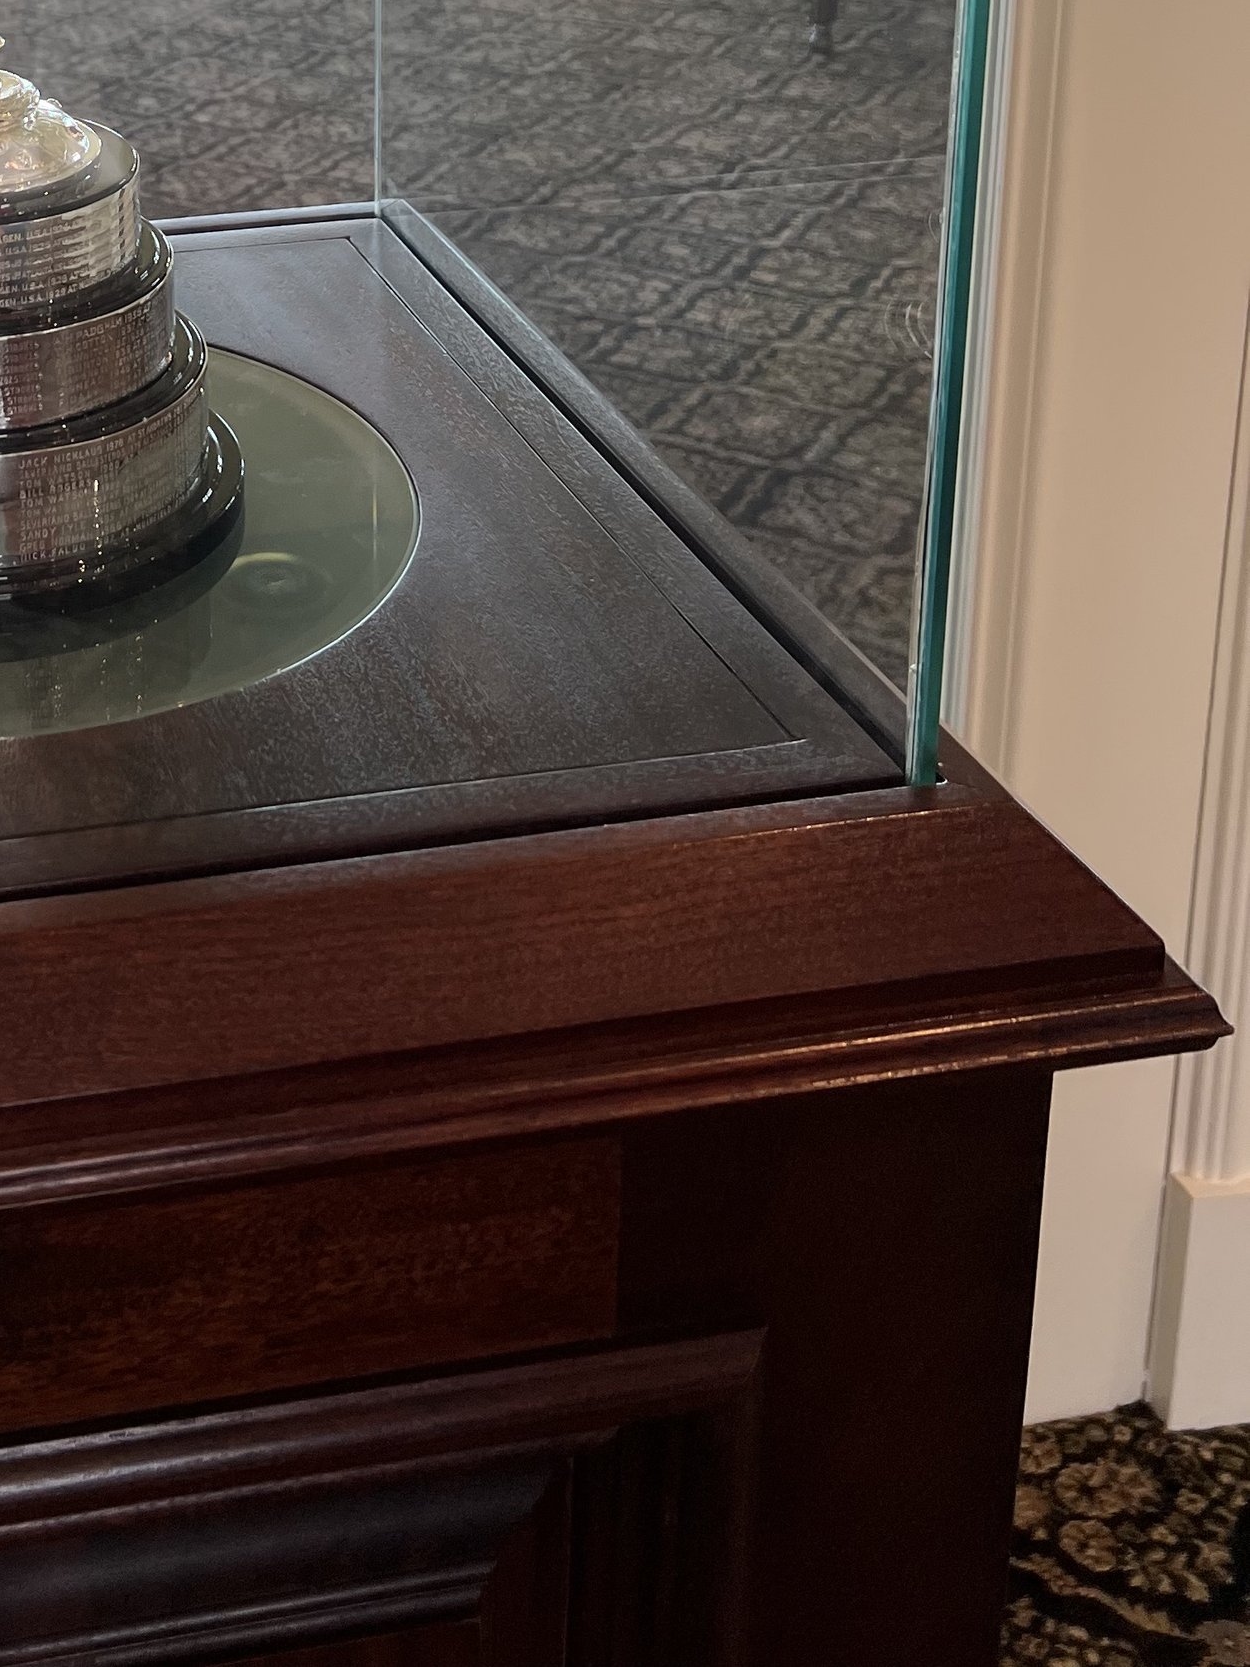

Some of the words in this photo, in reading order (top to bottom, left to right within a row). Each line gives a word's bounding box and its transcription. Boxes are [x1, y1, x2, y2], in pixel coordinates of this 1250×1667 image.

[76, 316, 123, 338] PADGM
[75, 334, 113, 352] COTTO
[18, 456, 48, 470] JACK
[53, 445, 102, 464] NICKLAUS
[19, 487, 44, 499] BILL
[49, 478, 91, 494] ROGERS
[20, 498, 44, 509] TOM
[48, 487, 91, 504] WATSO
[20, 526, 57, 541] SANDY
